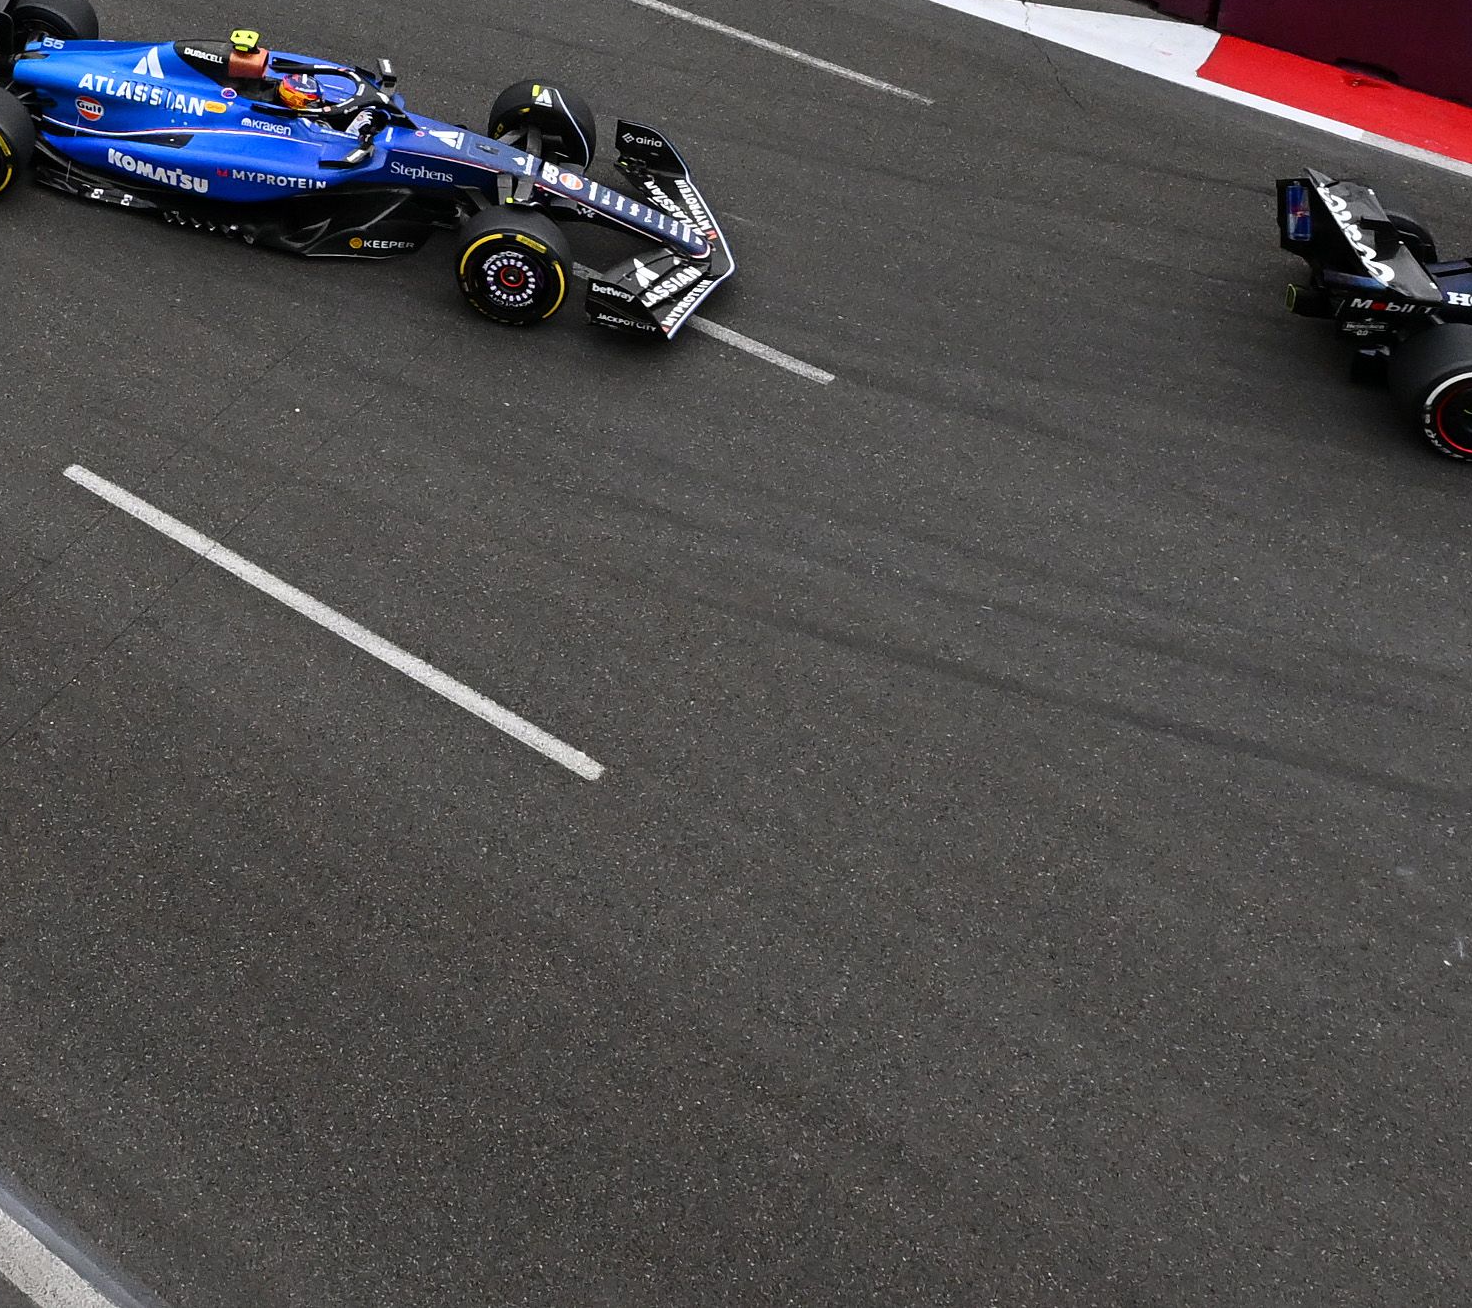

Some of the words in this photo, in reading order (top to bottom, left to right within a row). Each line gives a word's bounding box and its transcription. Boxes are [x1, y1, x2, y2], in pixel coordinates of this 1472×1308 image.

[42, 37, 65, 50] 55
[184, 47, 223, 65] DURACELL
[78, 73, 206, 117] ATLASSIAN
[77, 99, 103, 115] Gulf
[636, 134, 663, 148] airia
[107, 148, 209, 193] KOMATSU
[232, 169, 327, 190] MYPROTEIN
[390, 161, 453, 183] Stephens
[363, 238, 415, 250] KEEPER
[591, 283, 635, 304] betway
[642, 265, 702, 309] LASSIAN
[661, 279, 713, 326] MYPROTEIN
[596, 312, 633, 328] JACKPOT
[635, 321, 657, 332] CITY
